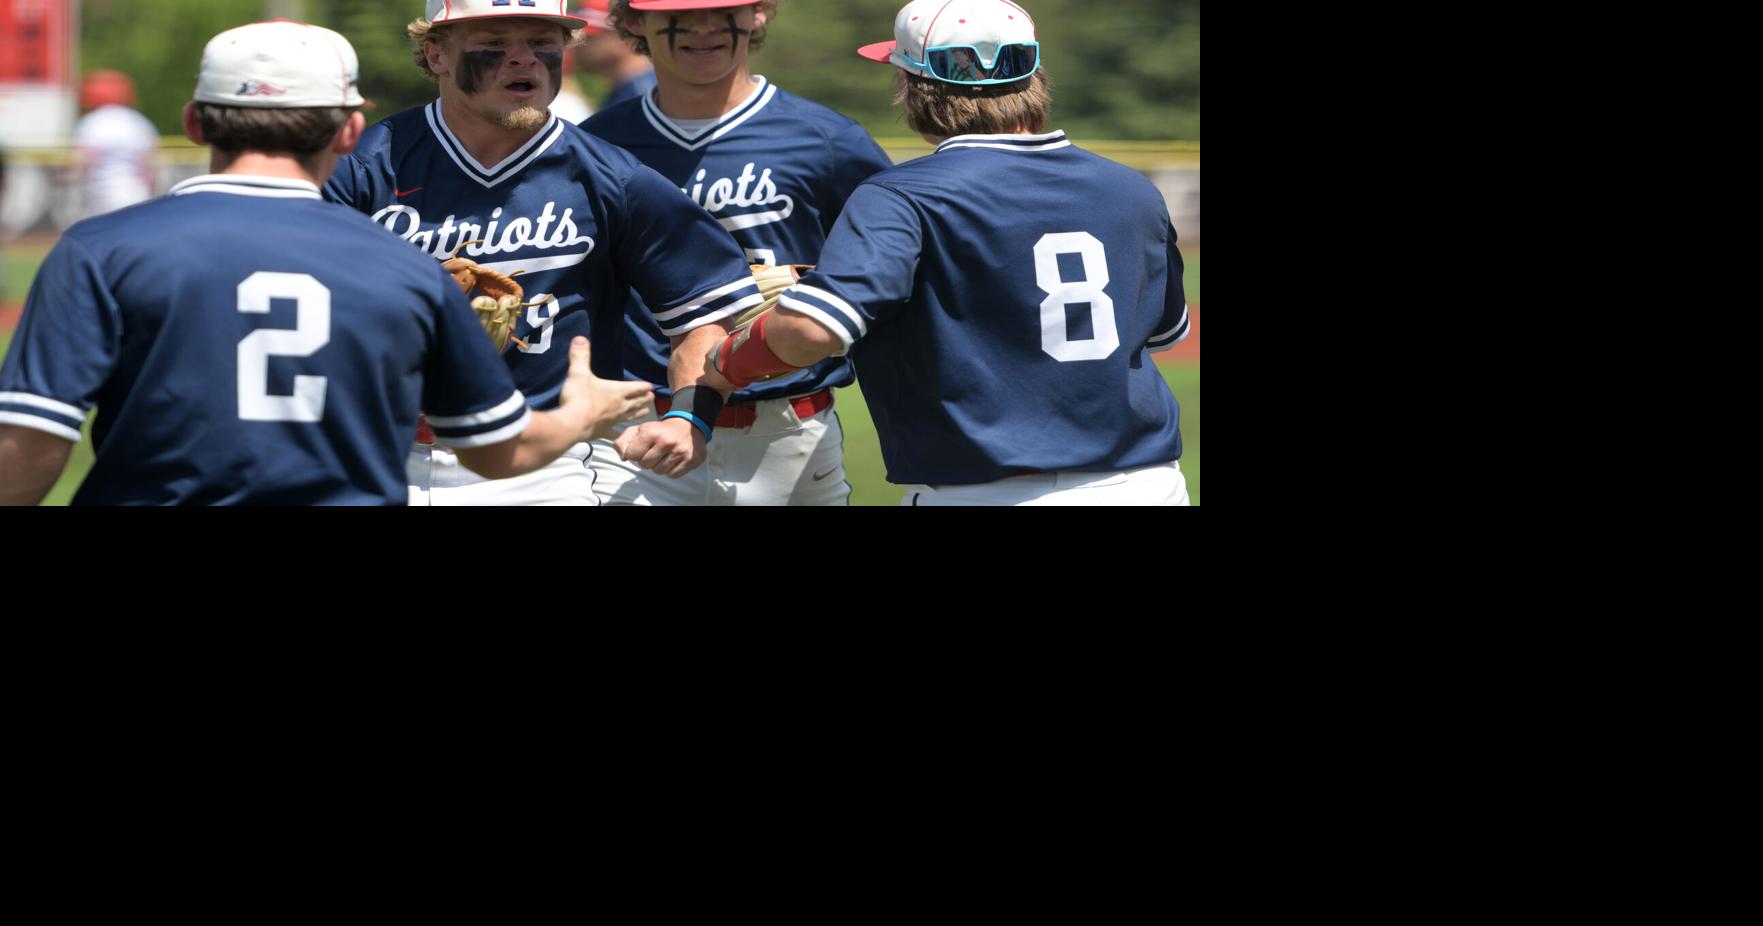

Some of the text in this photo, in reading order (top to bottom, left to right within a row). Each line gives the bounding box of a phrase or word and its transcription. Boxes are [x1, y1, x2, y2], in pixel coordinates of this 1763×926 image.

[681, 162, 784, 214] iots
[236, 271, 332, 422] 2
[1033, 231, 1120, 362] 8
